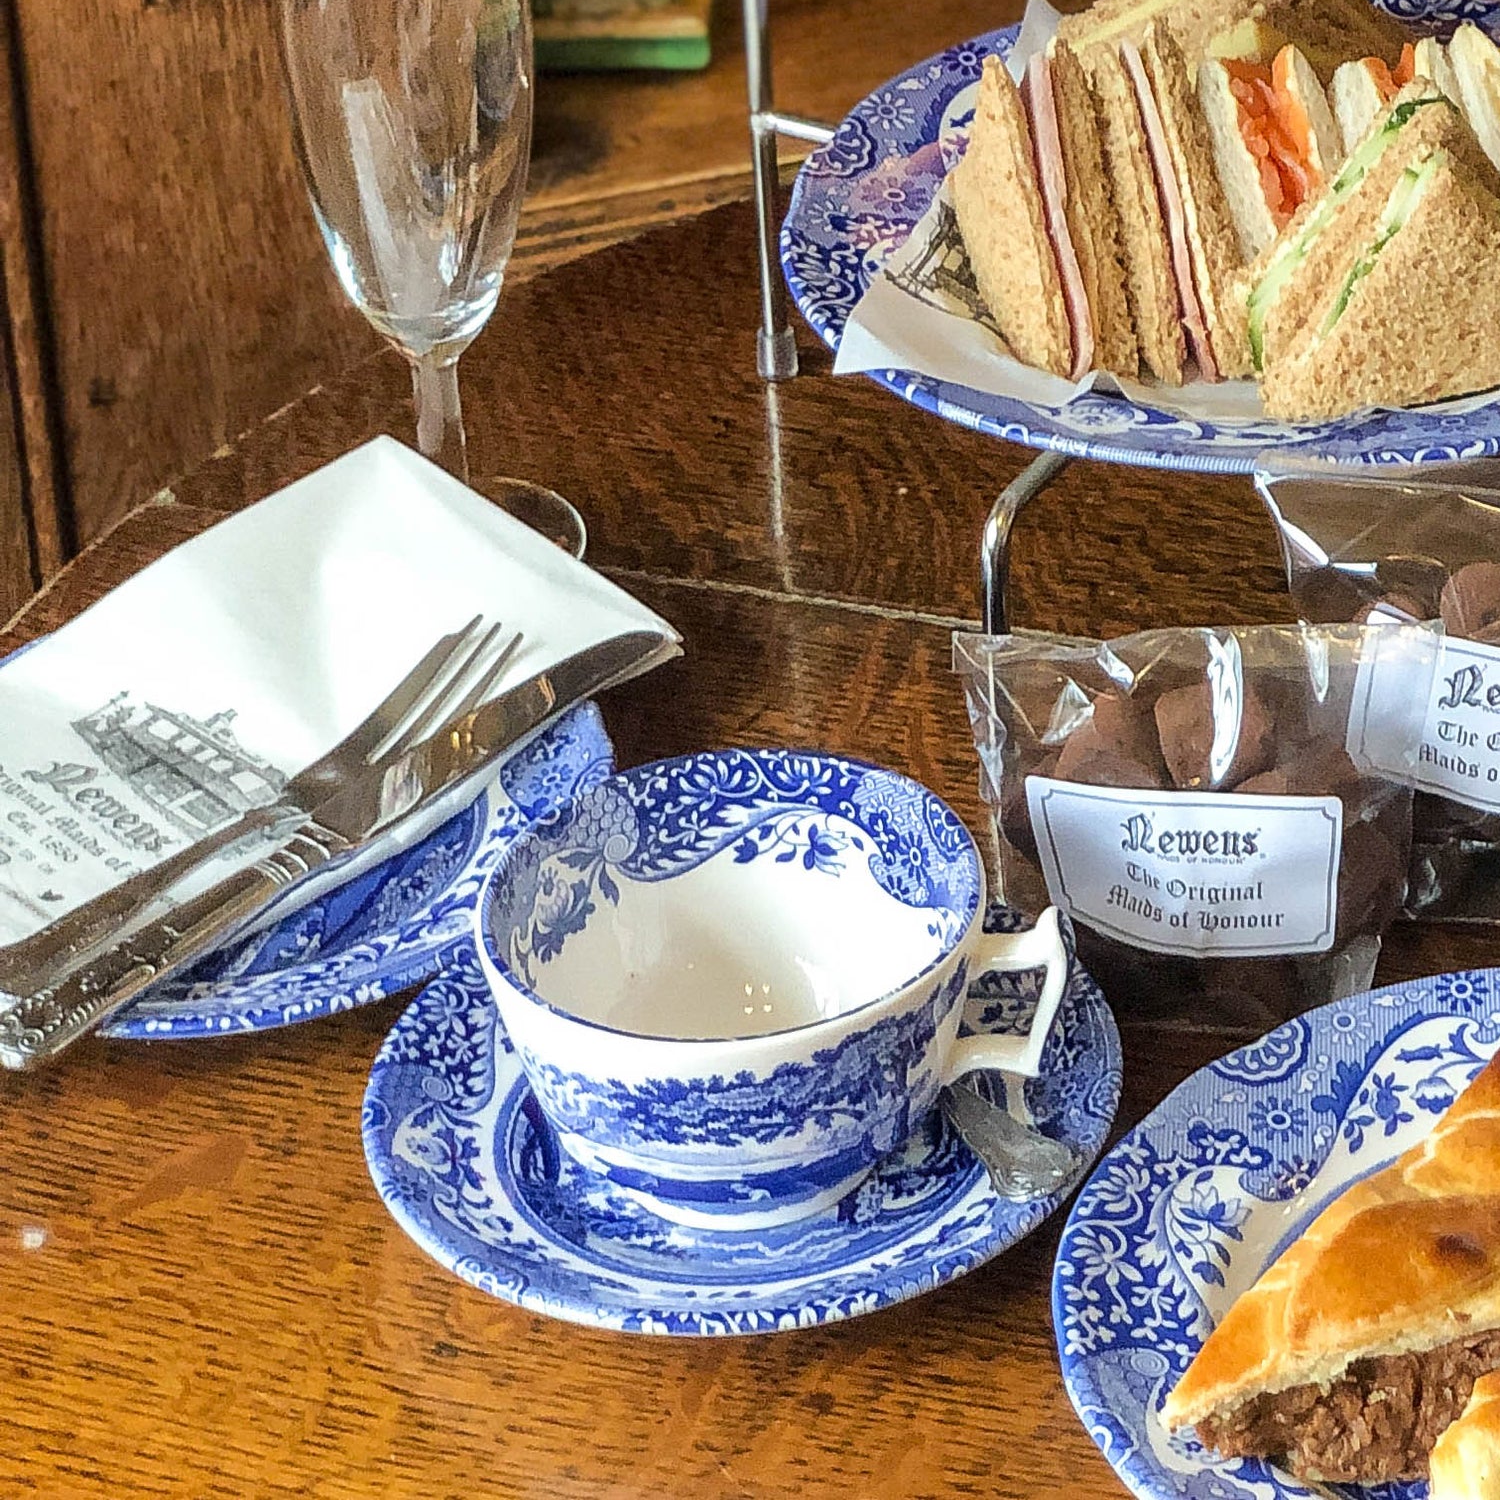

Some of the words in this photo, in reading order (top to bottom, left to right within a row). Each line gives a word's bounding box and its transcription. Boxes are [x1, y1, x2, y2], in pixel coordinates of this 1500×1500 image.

[1437, 720, 1479, 747] The
[1418, 743, 1479, 778] Maids
[1126, 861, 1160, 890] The
[1166, 879, 1263, 905] Original
[1106, 884, 1162, 923] Maids
[1169, 911, 1189, 929] of
[1198, 911, 1284, 932] Honour
